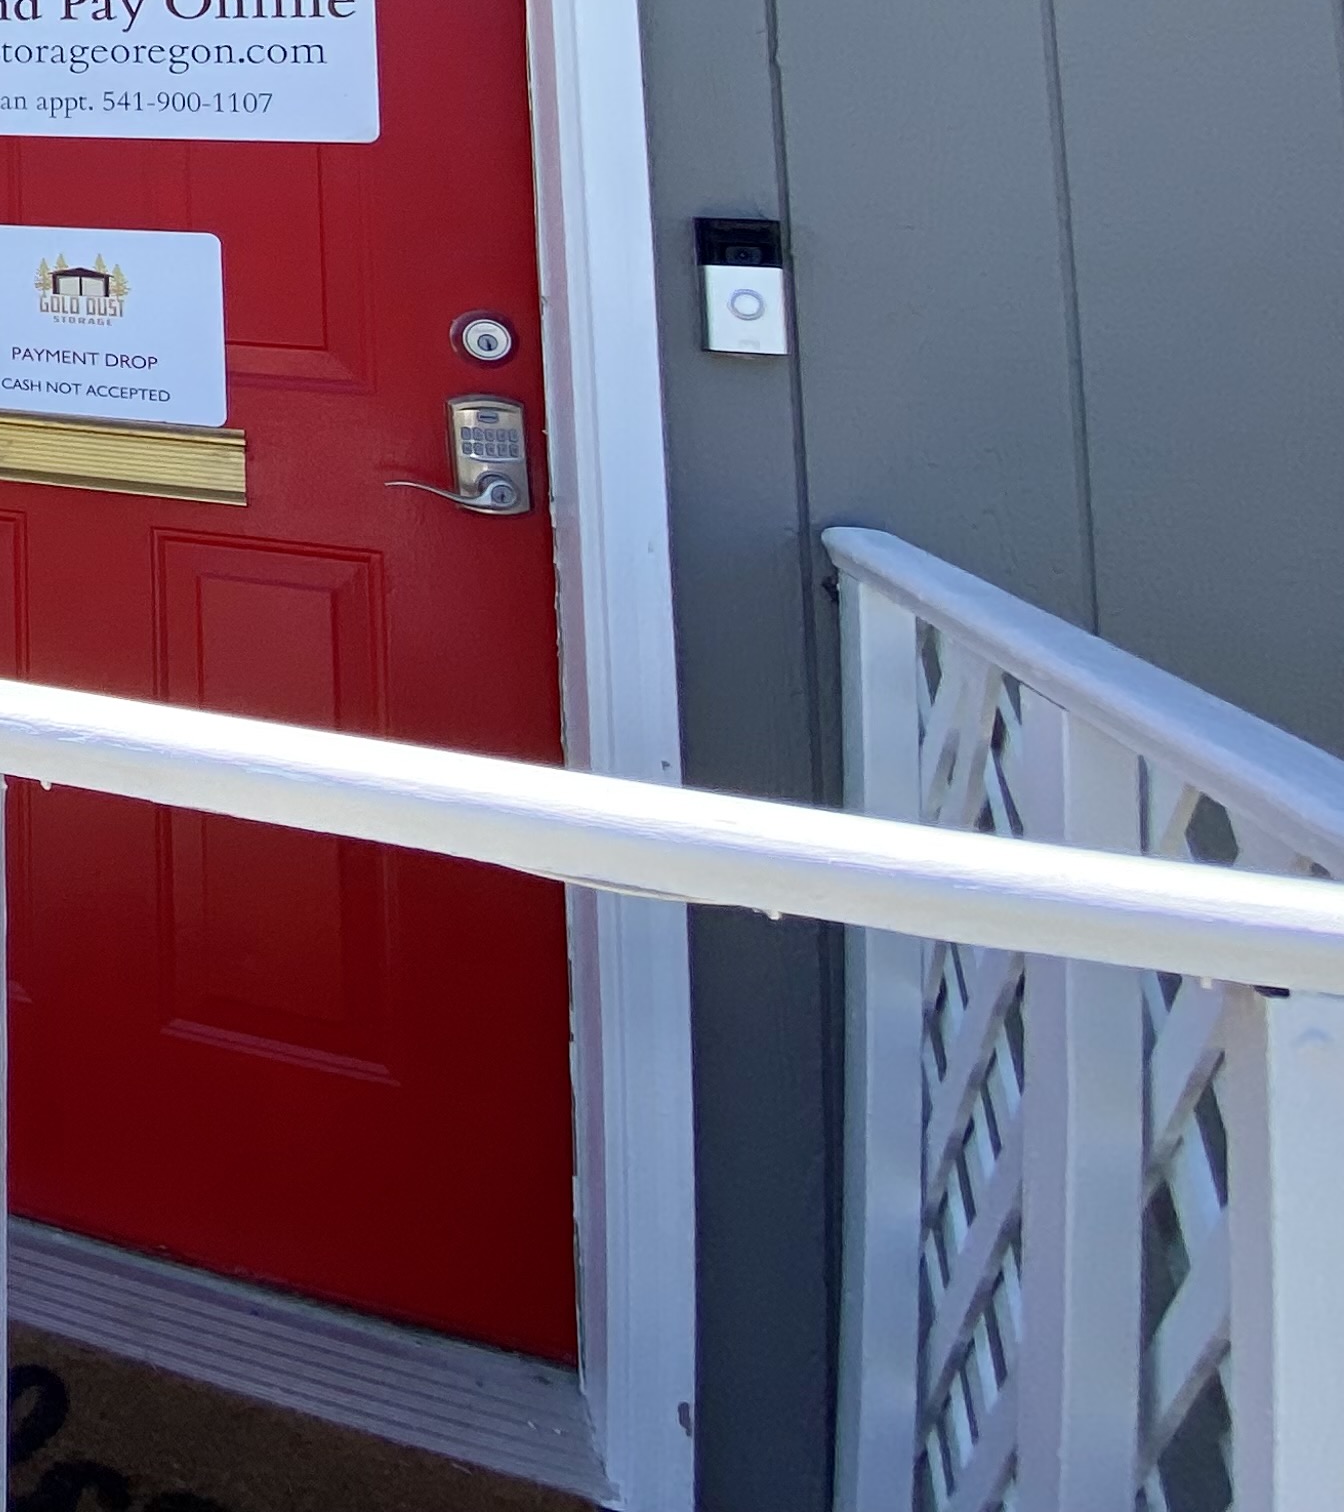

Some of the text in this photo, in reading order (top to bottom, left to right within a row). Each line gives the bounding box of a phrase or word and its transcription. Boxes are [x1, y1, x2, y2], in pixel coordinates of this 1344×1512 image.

[0, 95, 28, 111] an
[36, 96, 94, 119] appt.
[102, 90, 273, 114] 541-900-1107
[40, 296, 125, 317] GOLD DUST
[53, 315, 113, 326] STORAGE
[11, 346, 158, 370] PAYMENT DROP
[1, 377, 171, 403] CASH NOT ACCEPTED
